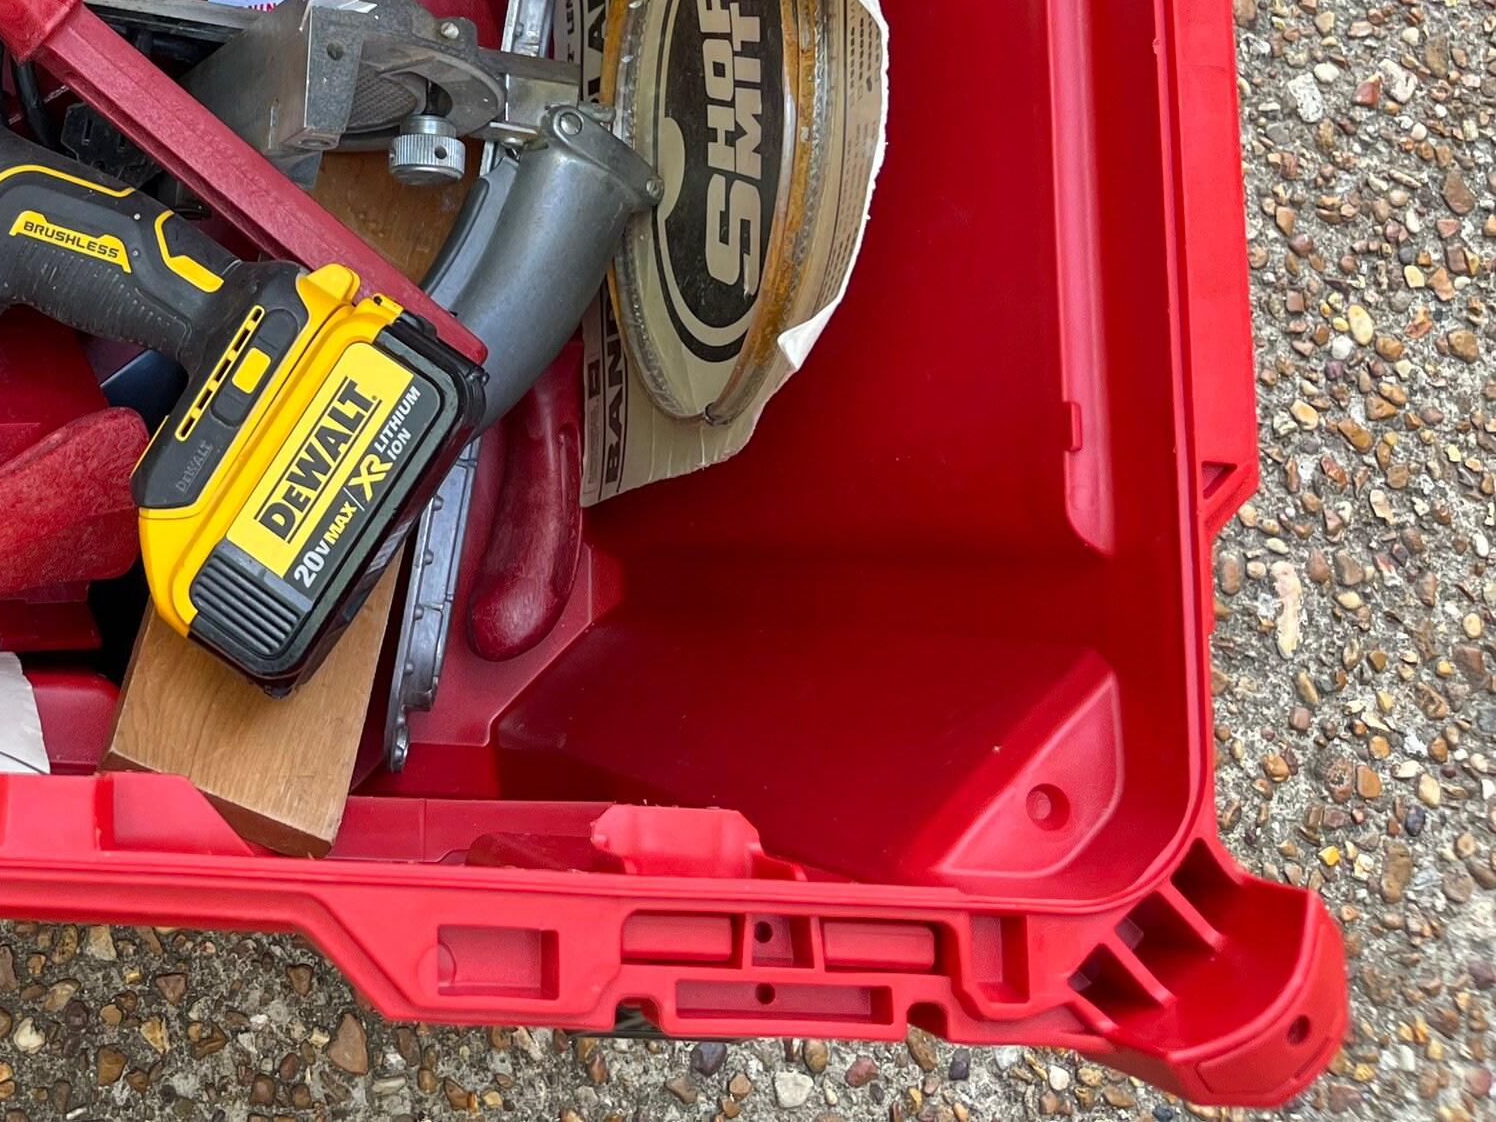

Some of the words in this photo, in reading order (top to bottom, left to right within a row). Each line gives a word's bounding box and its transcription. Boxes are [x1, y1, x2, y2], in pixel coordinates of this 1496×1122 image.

[23, 220, 120, 259] BRUSHLESS
[373, 385, 422, 454] LITHIUM
[387, 427, 413, 461] ION
[175, 440, 214, 494] DEWALT
[322, 500, 359, 546] MAX
[348, 453, 394, 504] XR
